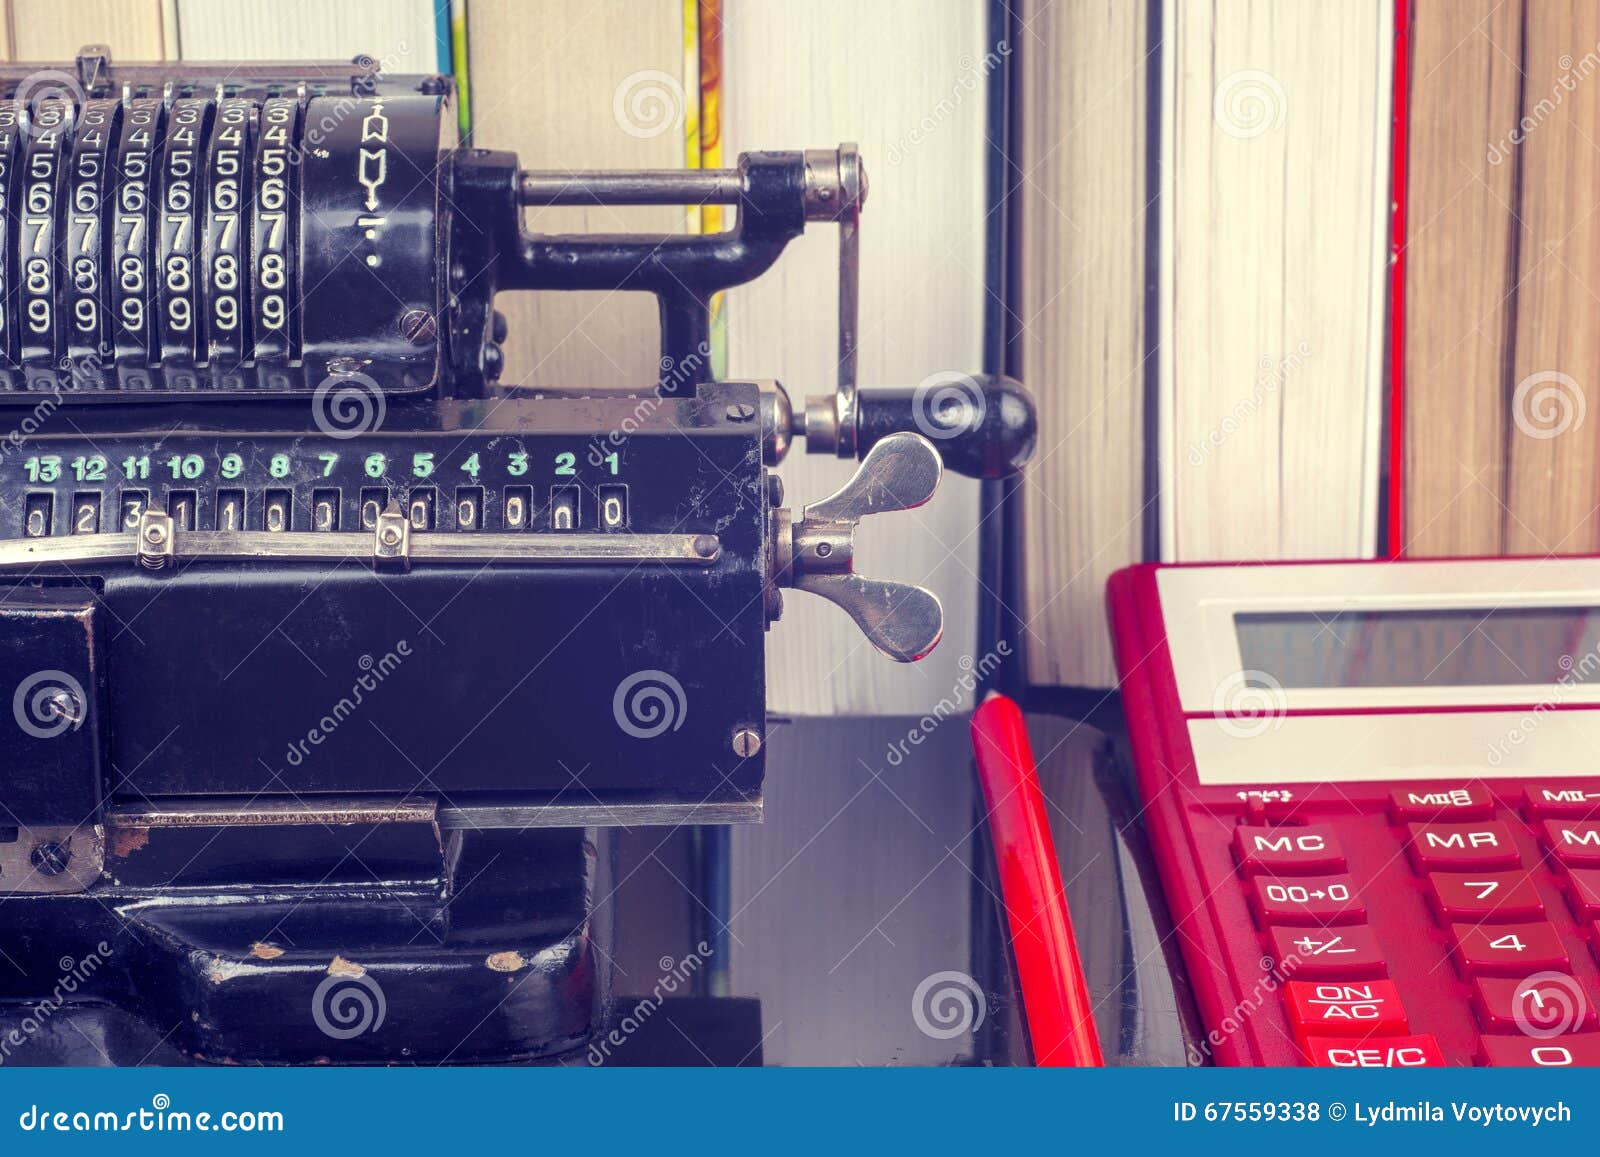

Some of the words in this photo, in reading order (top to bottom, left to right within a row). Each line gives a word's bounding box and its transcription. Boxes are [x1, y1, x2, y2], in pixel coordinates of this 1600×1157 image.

[39, 111, 60, 126] 3
[85, 111, 104, 124] 3
[131, 110, 150, 124] 3
[176, 109, 197, 124] 3
[222, 108, 244, 123] 3
[267, 108, 289, 122] 3
[36, 130, 56, 149] 4
[82, 129, 100, 148] 4
[128, 128, 150, 148] 4
[173, 127, 195, 146] 4
[219, 126, 242, 146] 4
[264, 126, 287, 146] 4
[32, 154, 54, 178] 5
[78, 153, 100, 177] 5
[124, 152, 146, 177] 5
[170, 151, 192, 176] 5
[216, 150, 238, 174] 5
[262, 149, 286, 175] 5
[28, 182, 52, 212] 6
[76, 182, 98, 212] 6
[122, 182, 145, 210] 6
[168, 180, 191, 210] 6
[214, 179, 238, 210] 6
[262, 178, 285, 209] 6
[28, 218, 49, 252] 7
[74, 218, 97, 252] 7
[121, 218, 143, 250] 7
[168, 216, 189, 250] 7
[214, 215, 238, 249] 7
[260, 214, 284, 248] 7
[28, 258, 49, 292] 8
[75, 258, 96, 292] 8
[122, 258, 144, 292] 8
[167, 256, 190, 291] 8
[214, 254, 237, 290] 8
[261, 254, 284, 289] 8
[28, 299, 50, 333] 9
[75, 298, 96, 332] 9
[122, 298, 144, 331] 9
[169, 298, 191, 330] 9
[216, 296, 238, 330] 9
[262, 295, 285, 329] 9
[24, 455, 61, 482] 13
[71, 455, 107, 481] 12
[123, 456, 150, 479] 11
[167, 454, 205, 479] 10
[221, 453, 243, 478] 9
[269, 453, 290, 478] 8
[318, 453, 338, 477] 7
[364, 452, 386, 478] 6
[413, 453, 434, 477] 5
[460, 453, 480, 477] 4
[507, 452, 528, 476] 3
[554, 452, 576, 476] 2
[606, 452, 618, 475] 1
[28, 510, 43, 537] 0
[77, 505, 95, 532] 2
[125, 501, 141, 528] 3
[177, 501, 186, 527] 1
[223, 502, 235, 531] 1
[267, 505, 283, 532] 0
[316, 502, 332, 528] 0
[363, 501, 380, 528] 0
[411, 501, 426, 529] 0
[458, 500, 474, 526] 0
[506, 497, 522, 526] 0
[604, 498, 621, 525] 0
[1254, 836, 1325, 851] MC
[1426, 832, 1498, 848] MR
[1464, 882, 1499, 899] 7
[1489, 935, 1526, 951] 4
[1316, 986, 1373, 1000] ON
[1520, 989, 1545, 1008] 1
[1323, 1005, 1380, 1019] AC
[1327, 1048, 1427, 1067] CE/C
